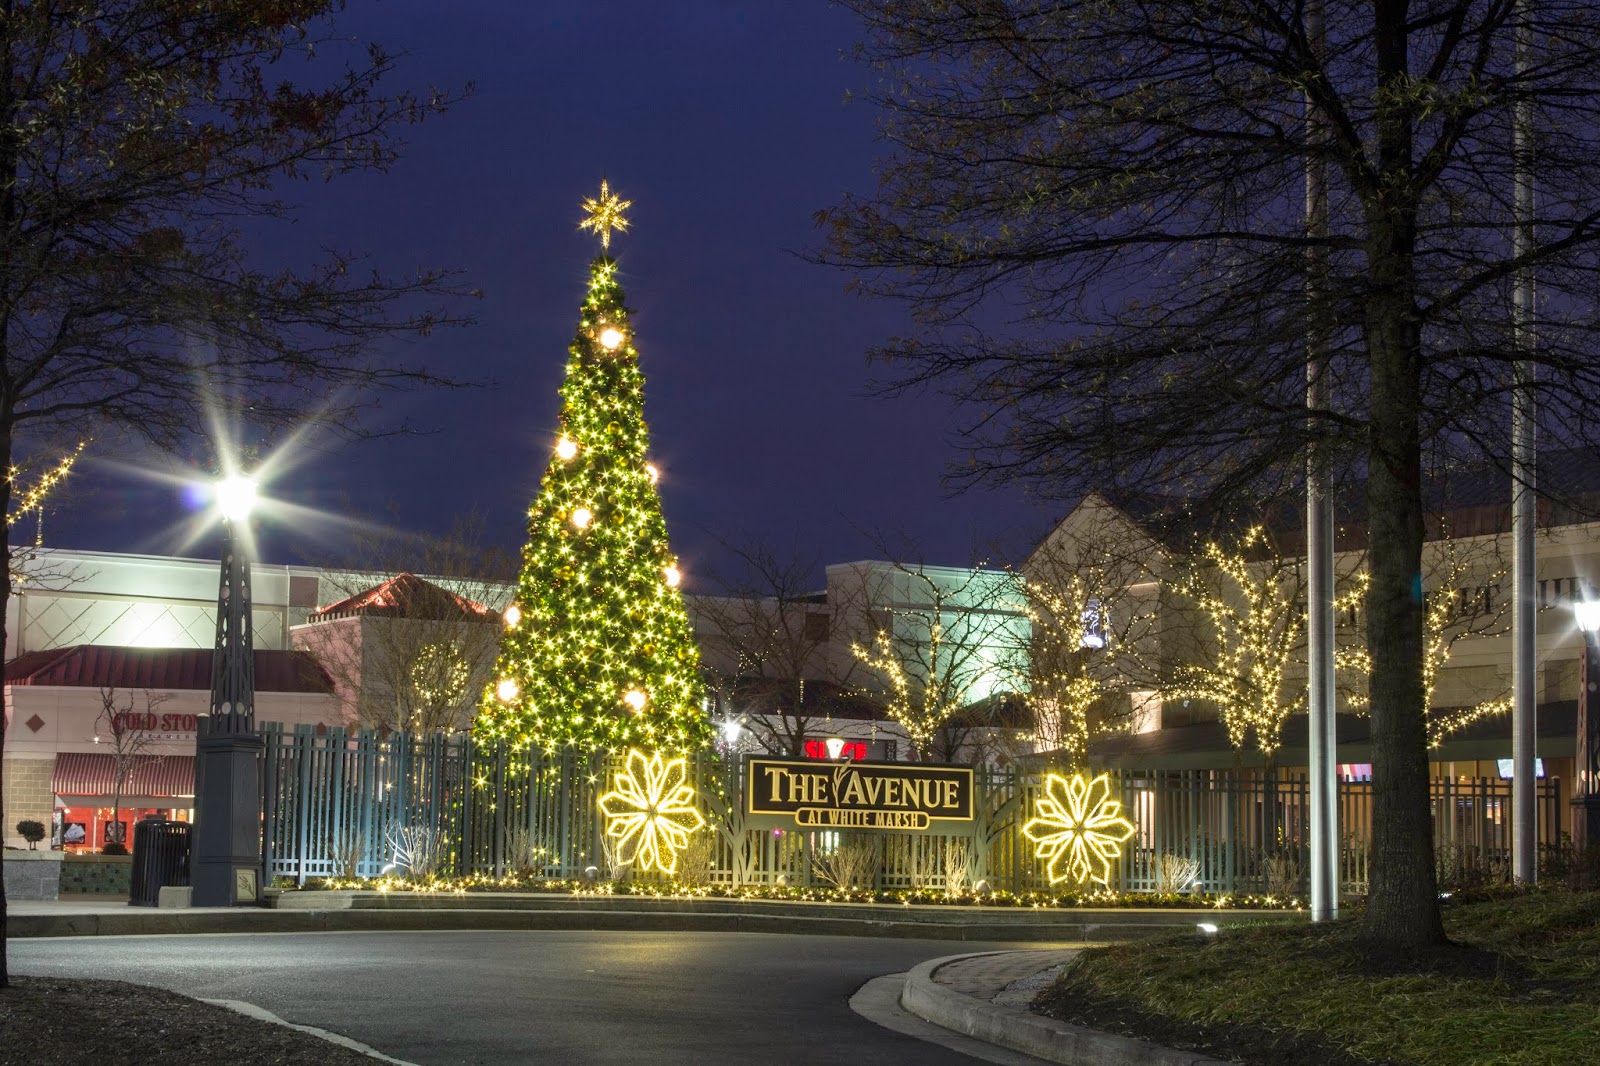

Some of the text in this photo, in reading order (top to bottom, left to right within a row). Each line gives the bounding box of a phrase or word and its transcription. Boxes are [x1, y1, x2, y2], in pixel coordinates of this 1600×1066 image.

[112, 712, 197, 734] COLD STO
[804, 739, 867, 760] SLCE
[764, 766, 960, 810] THE AVENUE
[807, 810, 919, 828] AT WHITE MARSH
